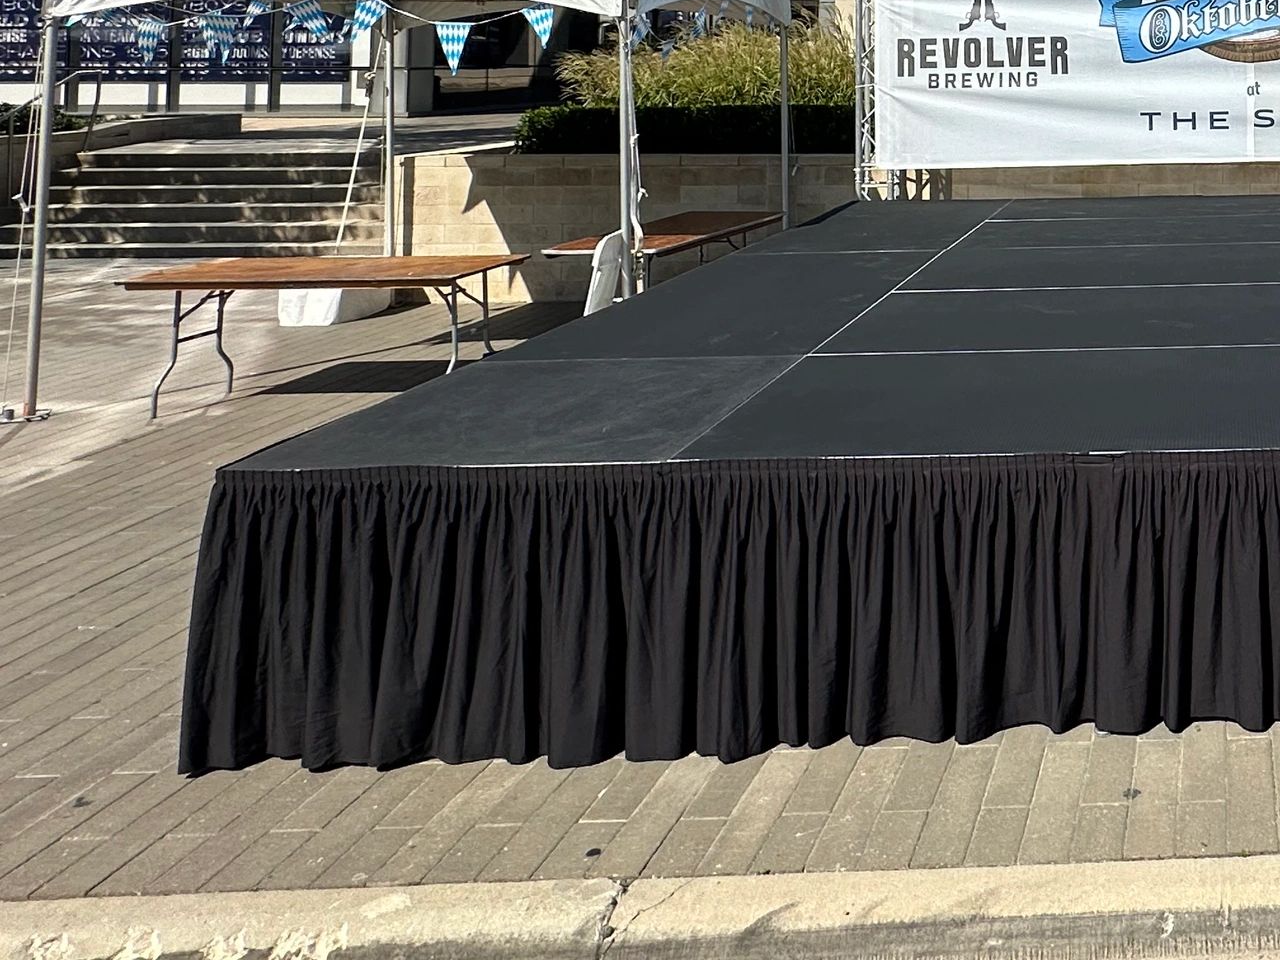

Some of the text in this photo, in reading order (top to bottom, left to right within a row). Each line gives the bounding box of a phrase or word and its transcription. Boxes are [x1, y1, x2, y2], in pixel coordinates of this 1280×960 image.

[897, 36, 1069, 77] REVOLVER
[928, 72, 1038, 89] BREWING
[1247, 81, 1260, 96] at
[1140, 111, 1229, 131] THE
